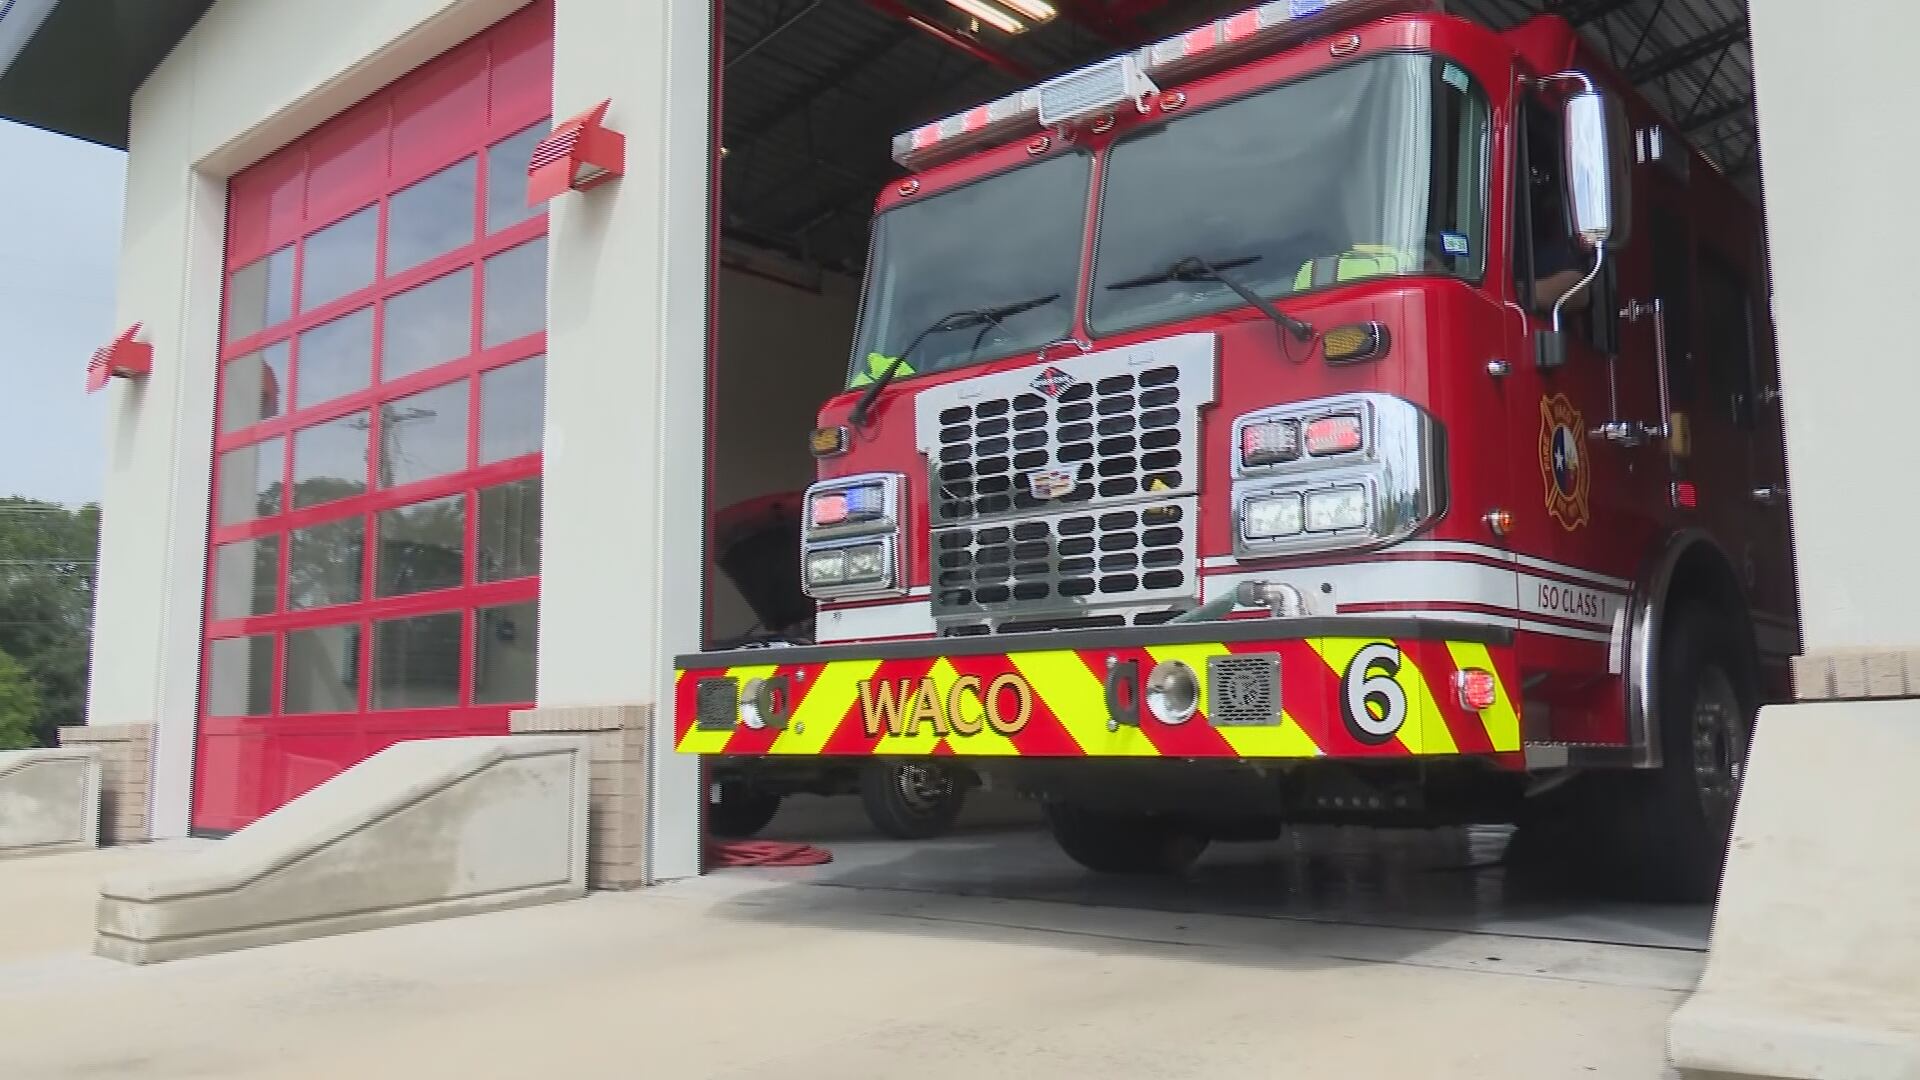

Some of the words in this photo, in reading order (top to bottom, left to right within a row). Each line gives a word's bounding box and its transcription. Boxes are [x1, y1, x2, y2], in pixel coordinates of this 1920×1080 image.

[1538, 584, 1559, 610] ISO
[1562, 588, 1598, 618] CLASS
[858, 672, 1034, 738] WACO
[1342, 643, 1406, 746] 6
